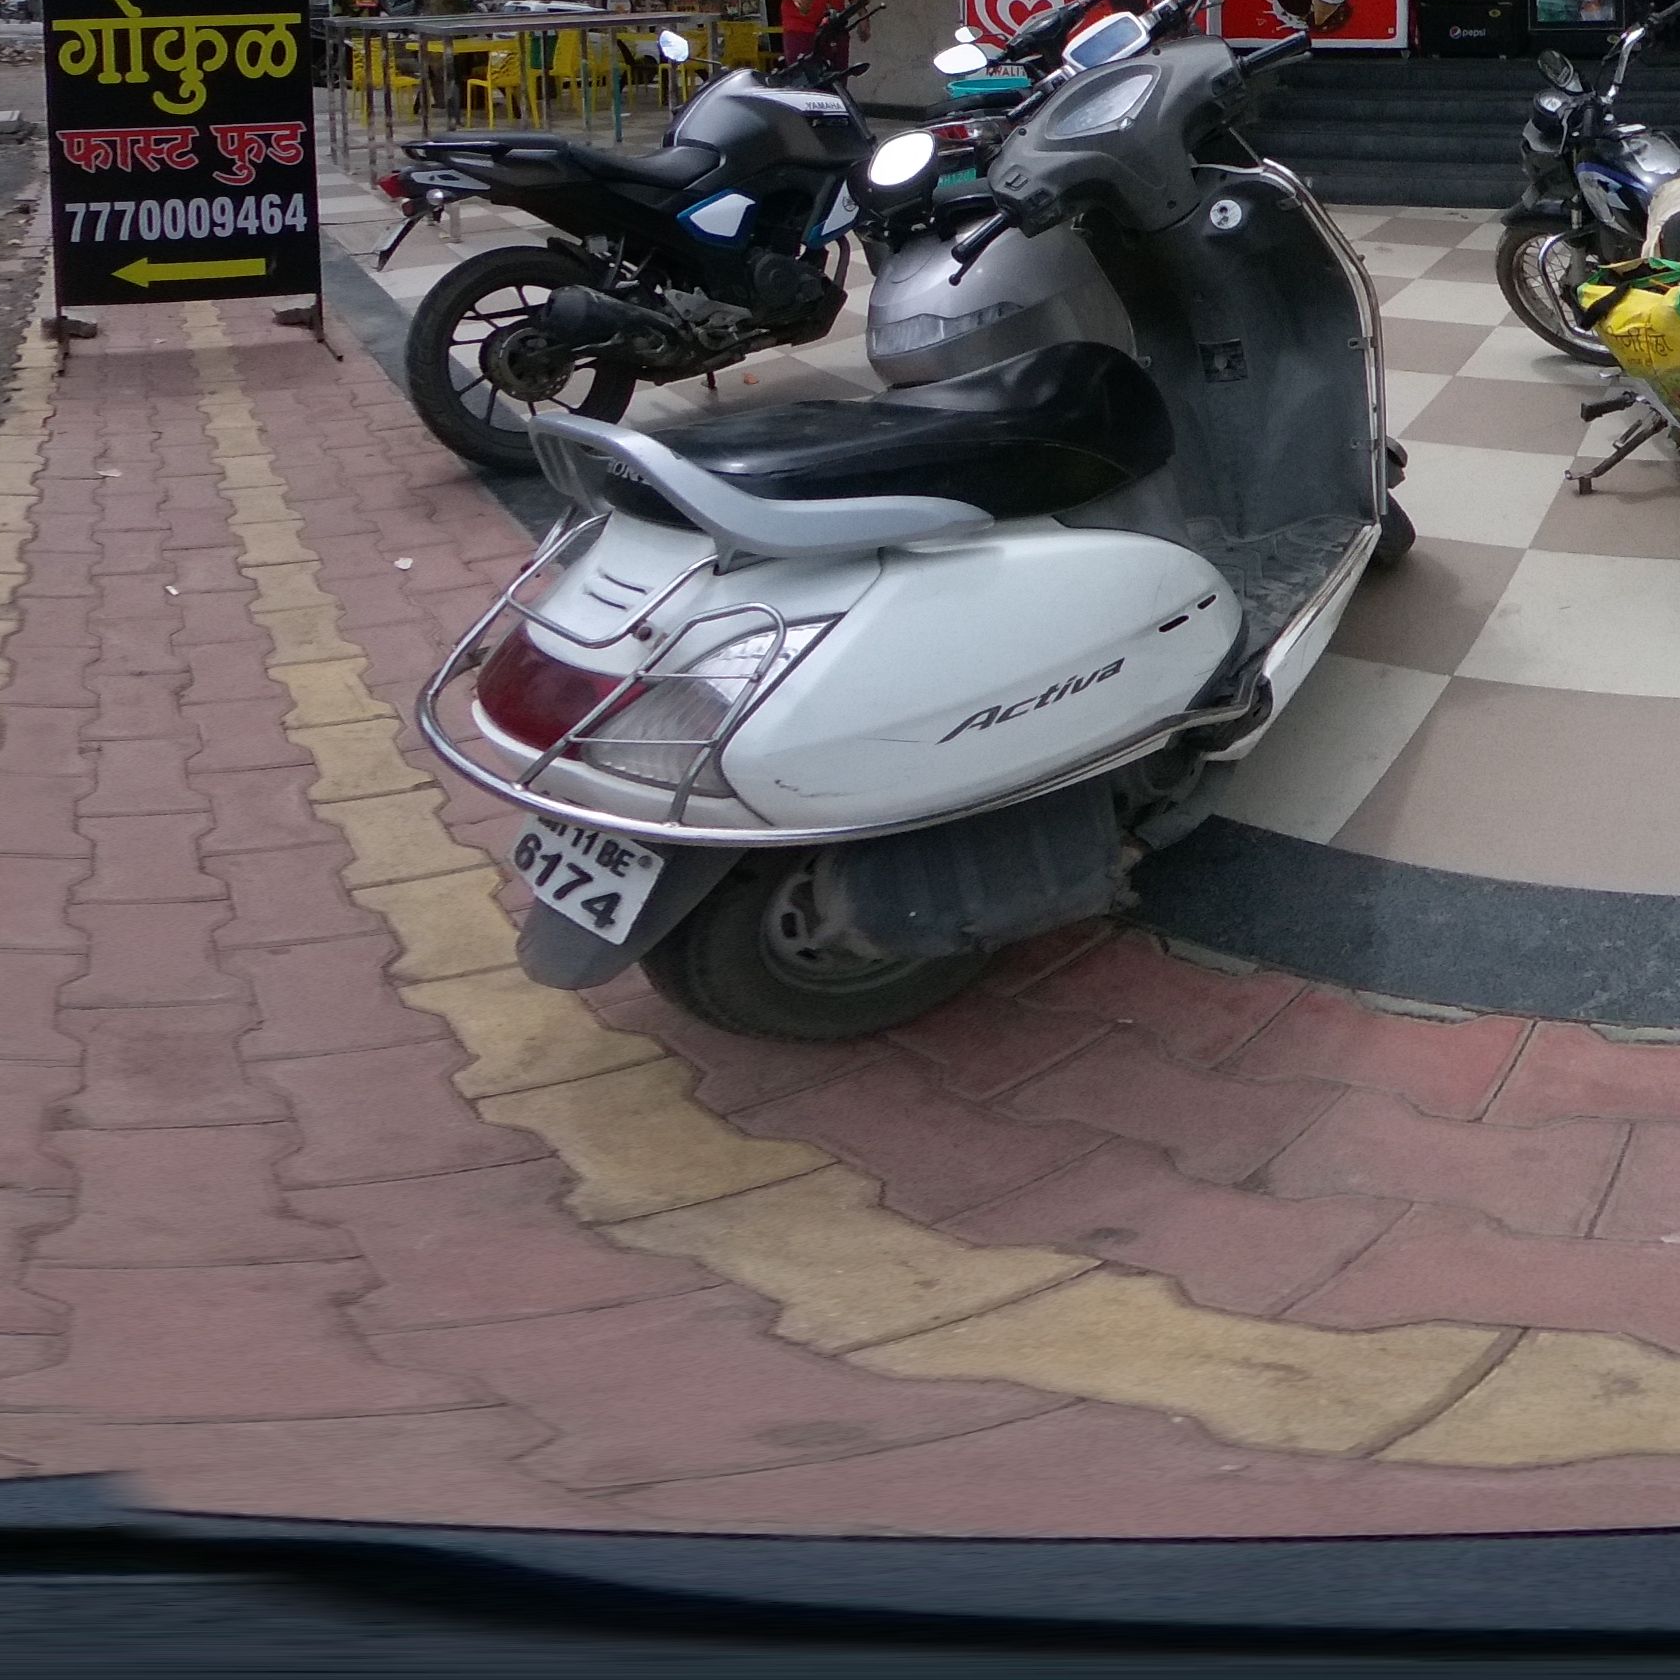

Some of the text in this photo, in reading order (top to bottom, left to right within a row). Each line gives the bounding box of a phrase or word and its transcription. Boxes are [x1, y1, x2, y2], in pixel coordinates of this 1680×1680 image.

[1463, 28, 1487, 38] pepsi
[806, 101, 843, 110] YAMAHA
[56, 121, 308, 186] फास्ट फुड
[65, 193, 308, 243] 7770009464
[934, 656, 1126, 745] Activa
[514, 833, 623, 929] 6174
[595, 838, 637, 878] BE
